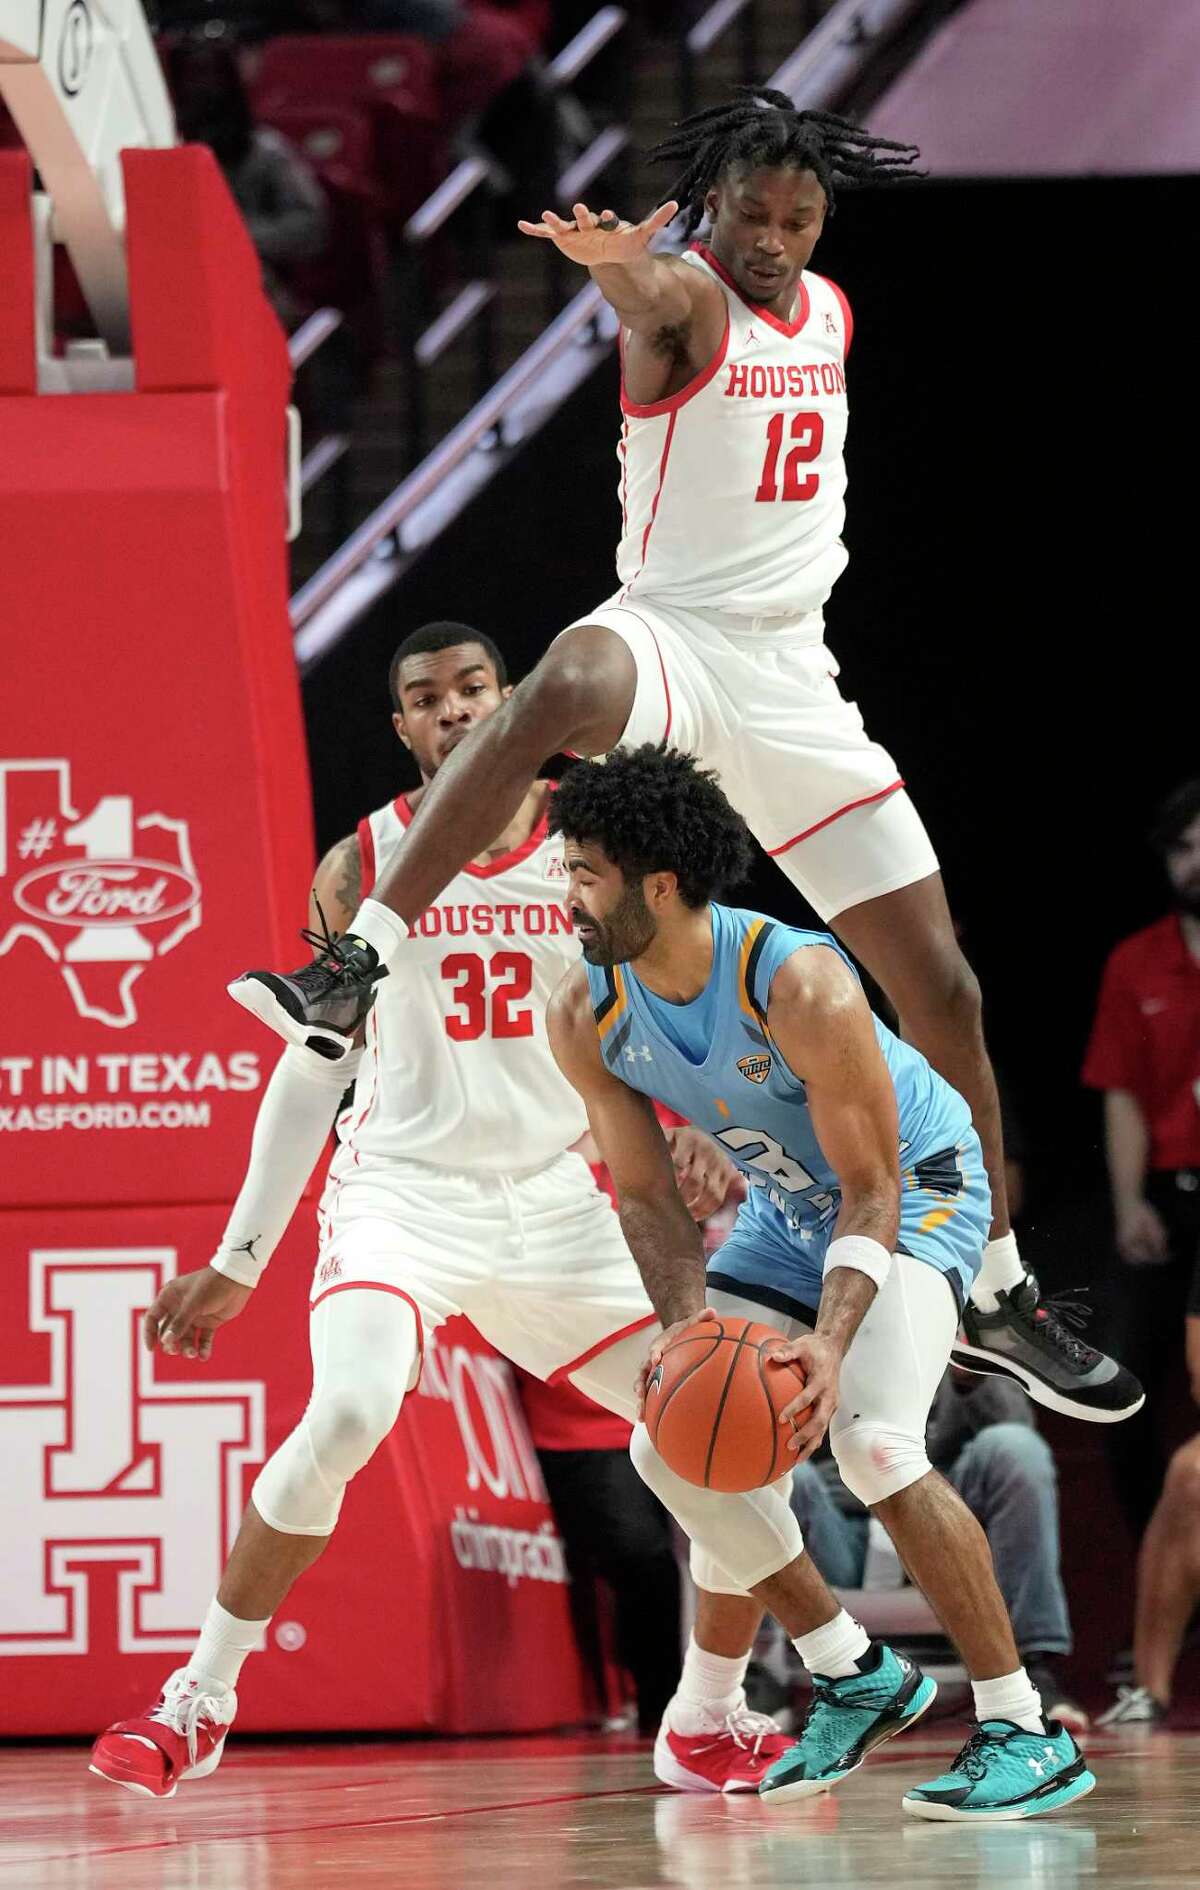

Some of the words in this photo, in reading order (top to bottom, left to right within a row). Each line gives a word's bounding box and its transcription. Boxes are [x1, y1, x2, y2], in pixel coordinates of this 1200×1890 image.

[724, 362, 846, 398] HOUSTON
[755, 412, 824, 502] 12
[46, 868, 168, 915] Ford
[407, 904, 574, 938] OUSTON
[441, 952, 533, 1042] 32
[41, 1055, 88, 1095] IN
[96, 1052, 261, 1093] TEXAS
